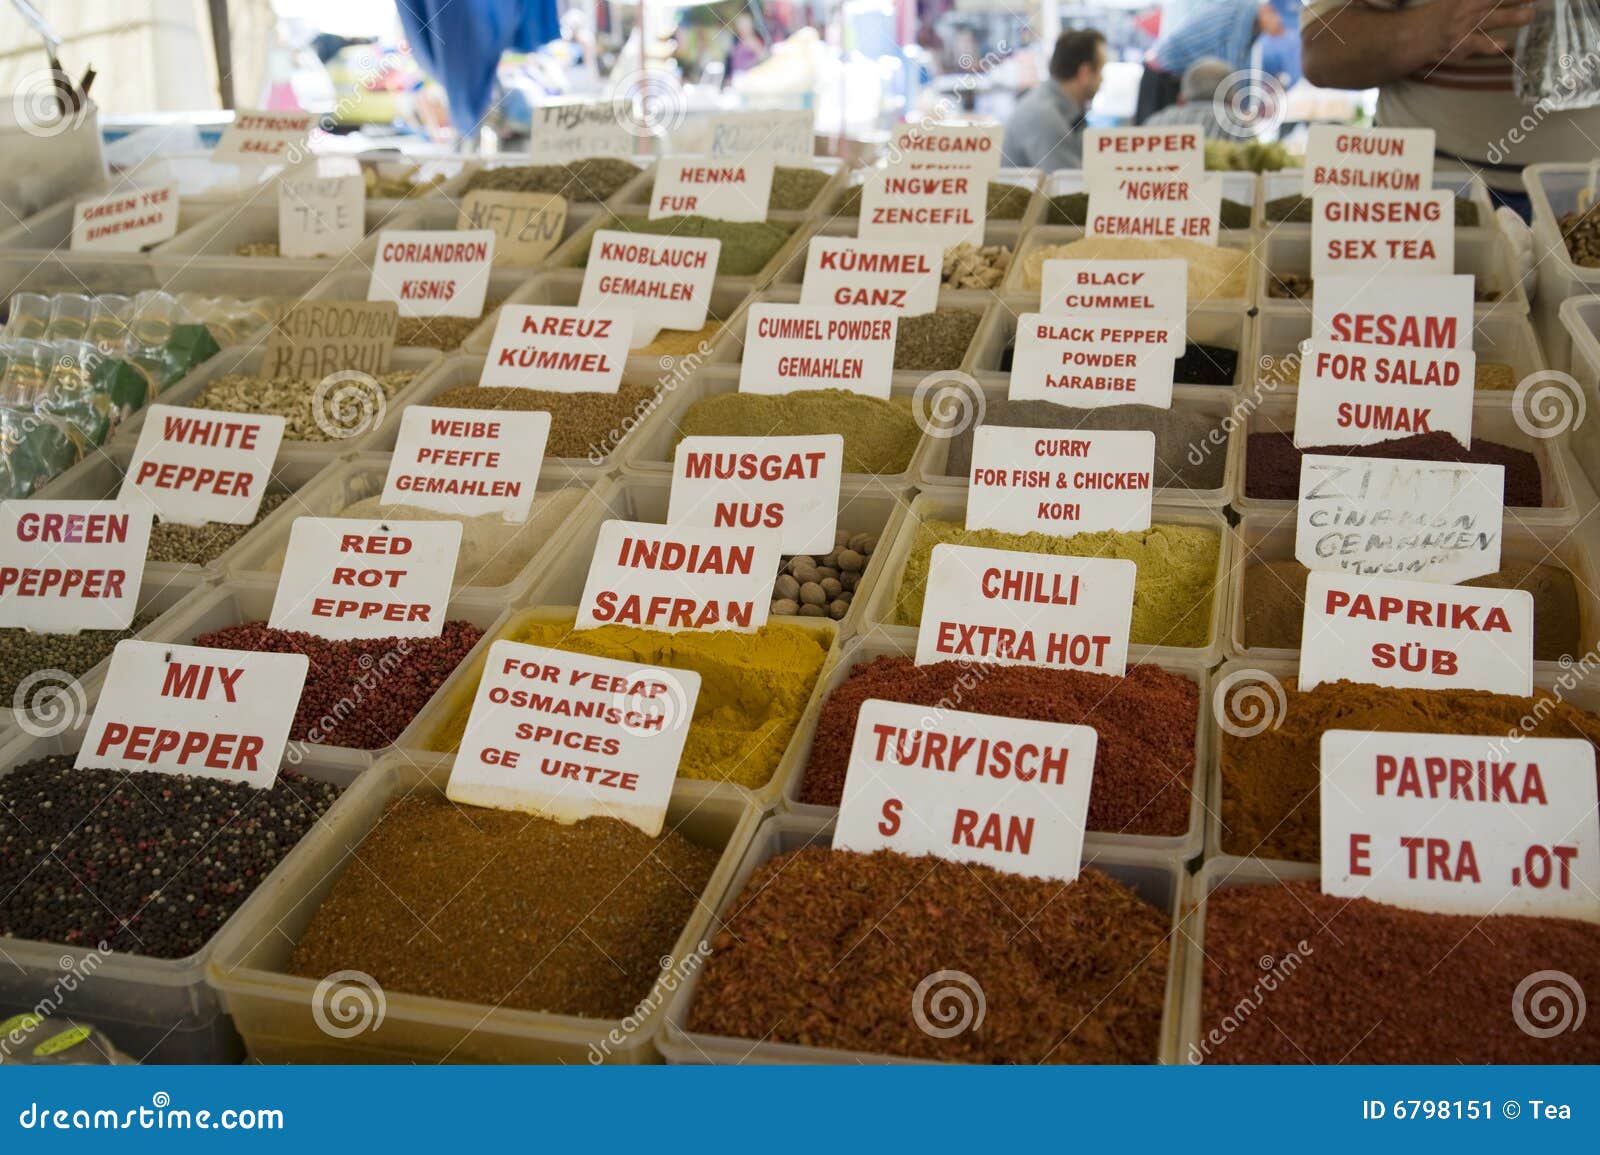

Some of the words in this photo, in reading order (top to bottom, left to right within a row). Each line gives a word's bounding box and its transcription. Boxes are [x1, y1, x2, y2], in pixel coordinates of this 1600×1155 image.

[236, 114, 311, 131] ZITRONE
[240, 140, 285, 155] SALZ
[901, 135, 992, 152] OREGANO
[1098, 135, 1194, 152] PEPPER
[1336, 135, 1404, 157] GRUUN
[681, 168, 745, 183] HENNA
[885, 179, 967, 195] INGWER
[83, 199, 137, 221] GREEN
[660, 196, 697, 212] FUR
[1325, 202, 1440, 222] GINSENG
[384, 243, 486, 262] CORIANDRON
[601, 244, 707, 267] KNOBLAUCH
[1328, 240, 1375, 259] SEX
[1387, 240, 1434, 260] TEA
[820, 252, 929, 273] KÜMMEL
[600, 275, 693, 300] GEMAHLEN
[834, 287, 905, 307] GANZ
[1066, 295, 1154, 309] CUMMEL
[758, 318, 822, 340] CUMMEL
[828, 320, 892, 340] POWDER
[1037, 325, 1094, 341] BLACK
[1101, 328, 1167, 343] PEPPER
[1331, 313, 1456, 347] SESAM
[499, 349, 610, 373] KÜMMEL
[778, 356, 862, 379] GEMAHLEN
[1063, 352, 1135, 367] POWDER
[1317, 353, 1366, 381] FOR
[1376, 358, 1459, 386] SALAD
[1336, 402, 1432, 433] SUMAK
[165, 417, 259, 449] WHITE
[1035, 439, 1090, 457] CURRY
[686, 453, 825, 480] MUSGAT
[136, 462, 253, 497] PEPPER
[396, 476, 521, 496] GEMAHLEN
[974, 468, 1007, 486] FOR
[1013, 470, 1050, 488] FISH
[1056, 472, 1068, 489] &
[1074, 472, 1149, 489] CHICKEN
[715, 503, 784, 528] NUS
[1038, 503, 1080, 520] KORI
[18, 513, 128, 543] GREEN
[341, 535, 412, 555] RED
[618, 538, 754, 574] INDIAN
[0, 568, 125, 598] PEPPER
[333, 568, 407, 587] ROT
[982, 568, 1078, 605] CHILLI
[592, 592, 752, 628] SAFRAN
[1325, 590, 1511, 632] PAPRIKA
[936, 622, 1035, 661] EXTRA
[1046, 633, 1110, 666] HOT
[503, 659, 560, 683] FOR
[162, 663, 244, 702] MIX
[489, 687, 665, 731] OSMANISCH
[97, 723, 264, 771] PEPPER
[515, 723, 620, 756] SPICES
[1376, 754, 1548, 806] PAPRIKA
